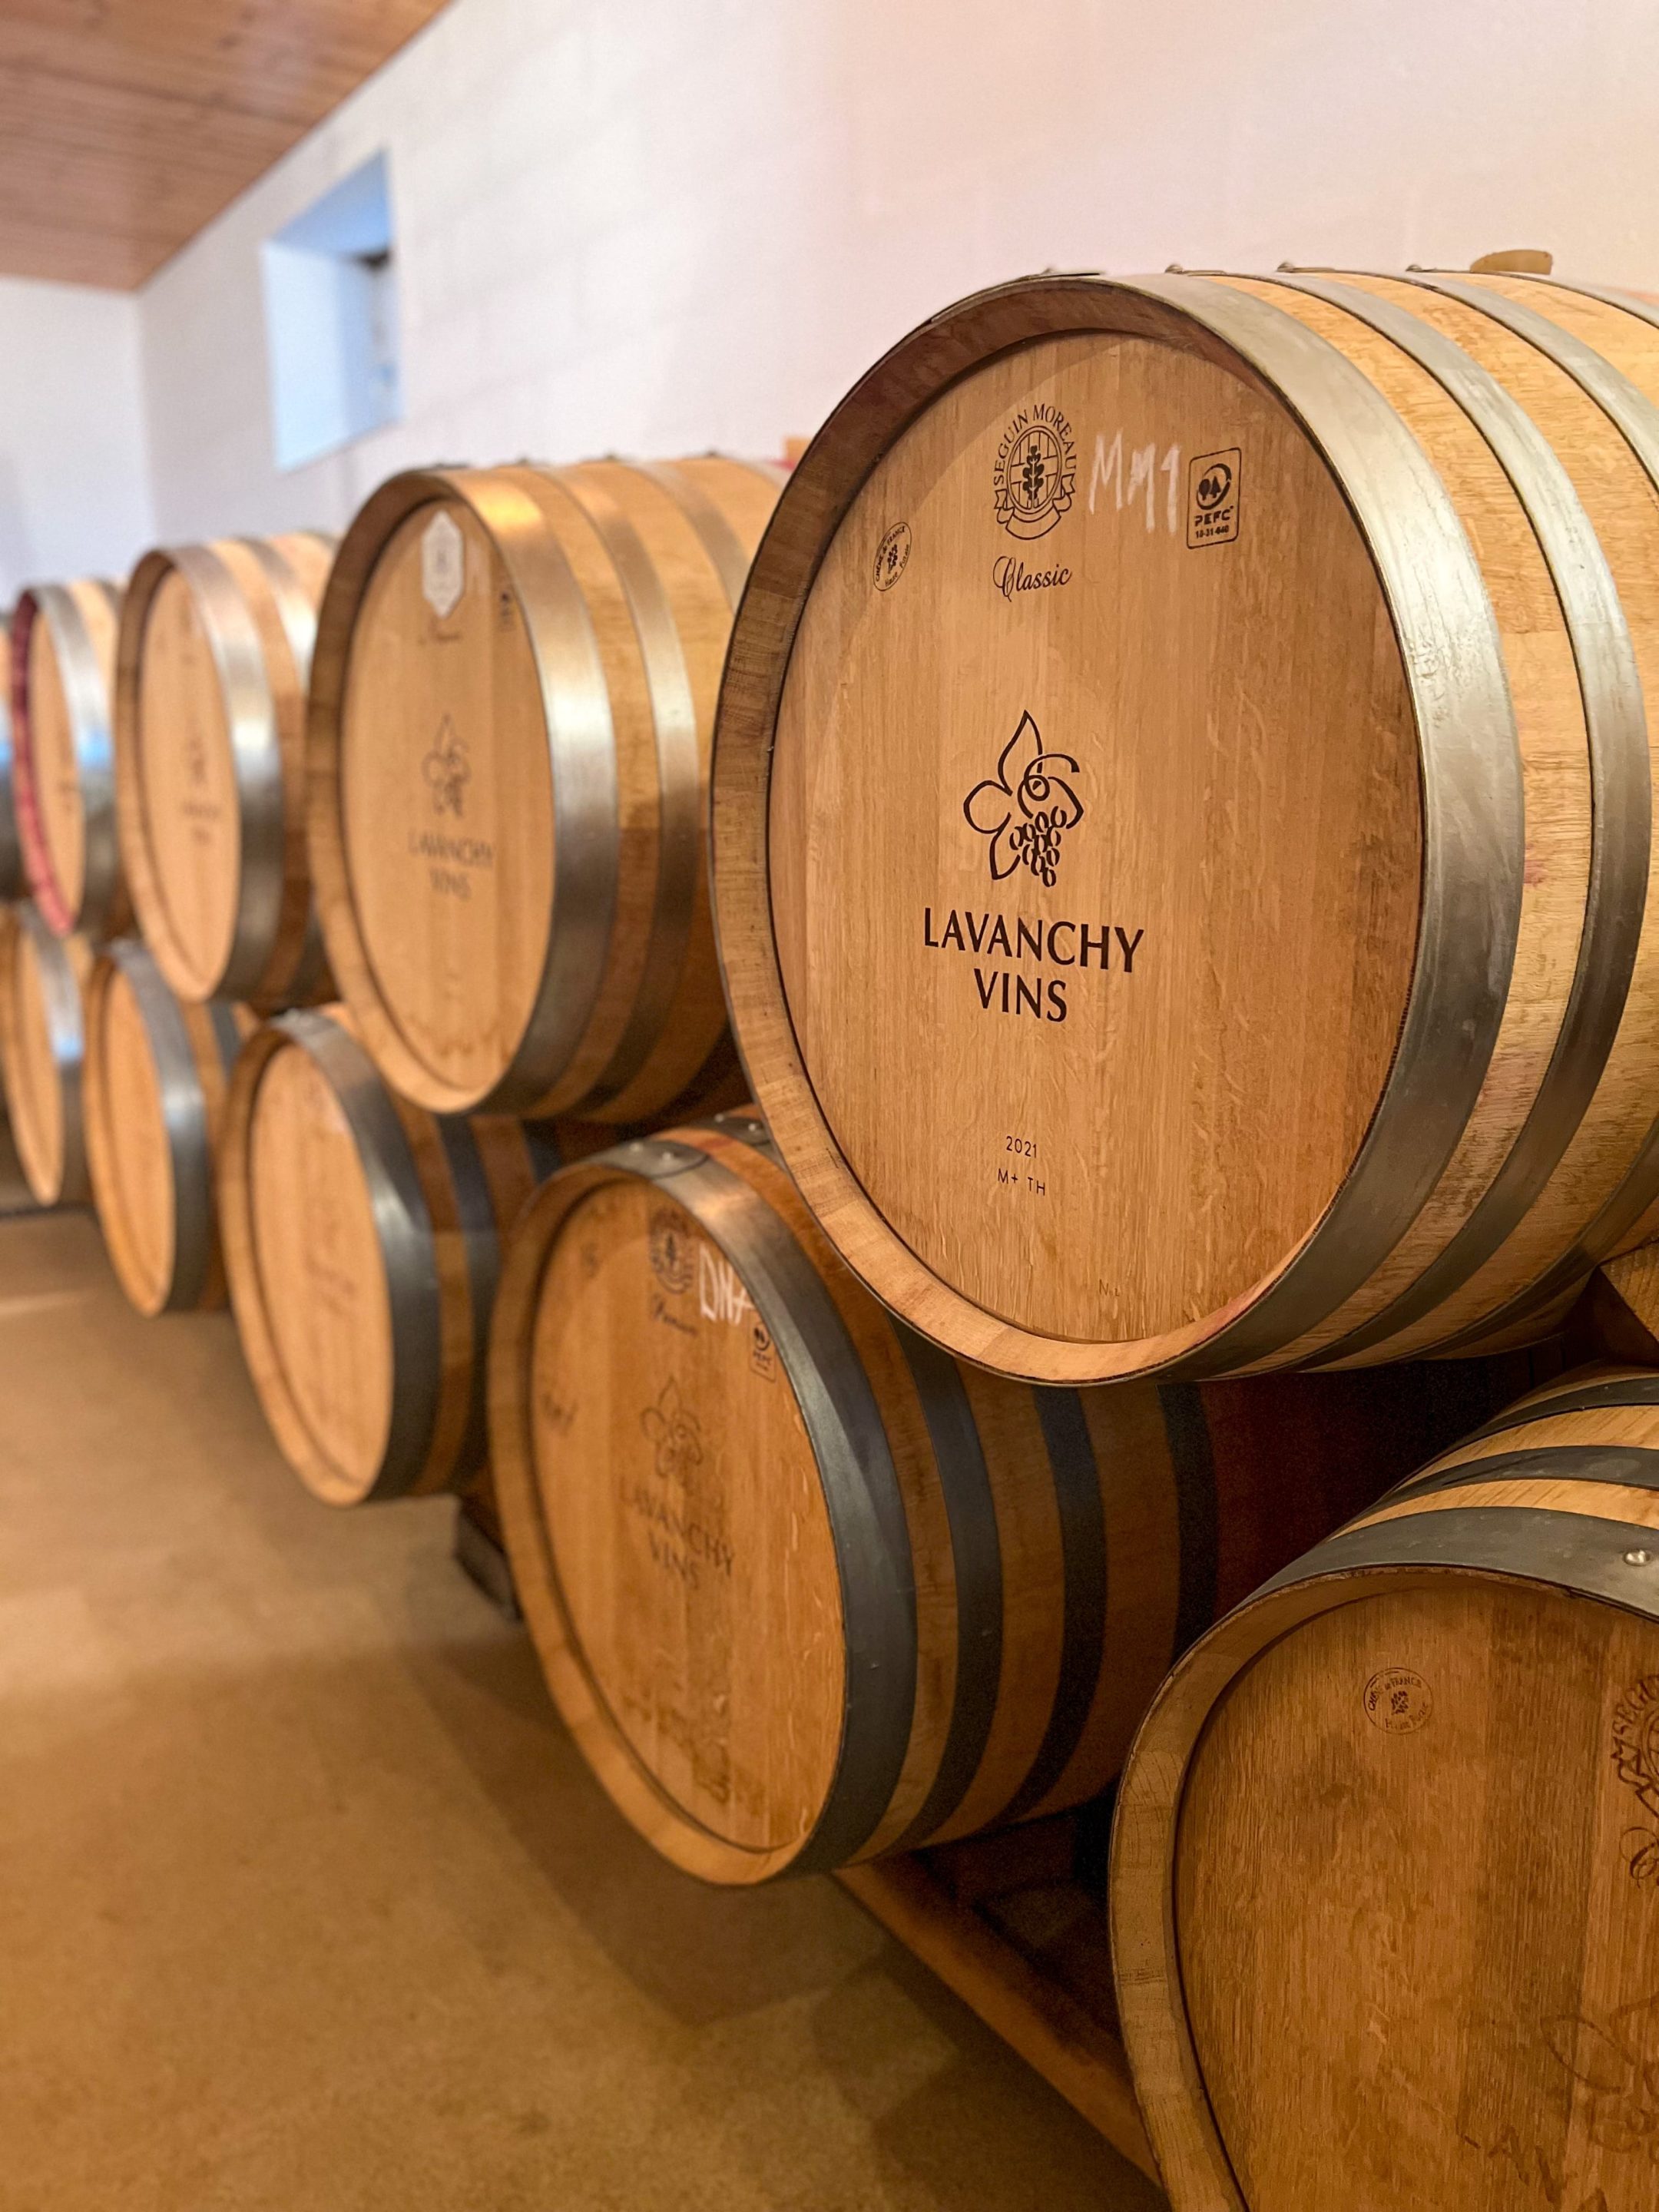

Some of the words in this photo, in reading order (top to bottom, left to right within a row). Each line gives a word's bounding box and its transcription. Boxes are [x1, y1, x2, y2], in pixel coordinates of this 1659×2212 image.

[993, 409, 1028, 486] SEGUIN
[1033, 403, 1077, 470] MOREAU
[1194, 508, 1231, 527] PEFC
[992, 555, 1073, 603] Classic
[924, 907, 1144, 972] LAVANCHY
[973, 968, 1068, 1023] VINS
[1006, 1135, 1037, 1159] 2021
[1027, 1176, 1046, 1197] TH
